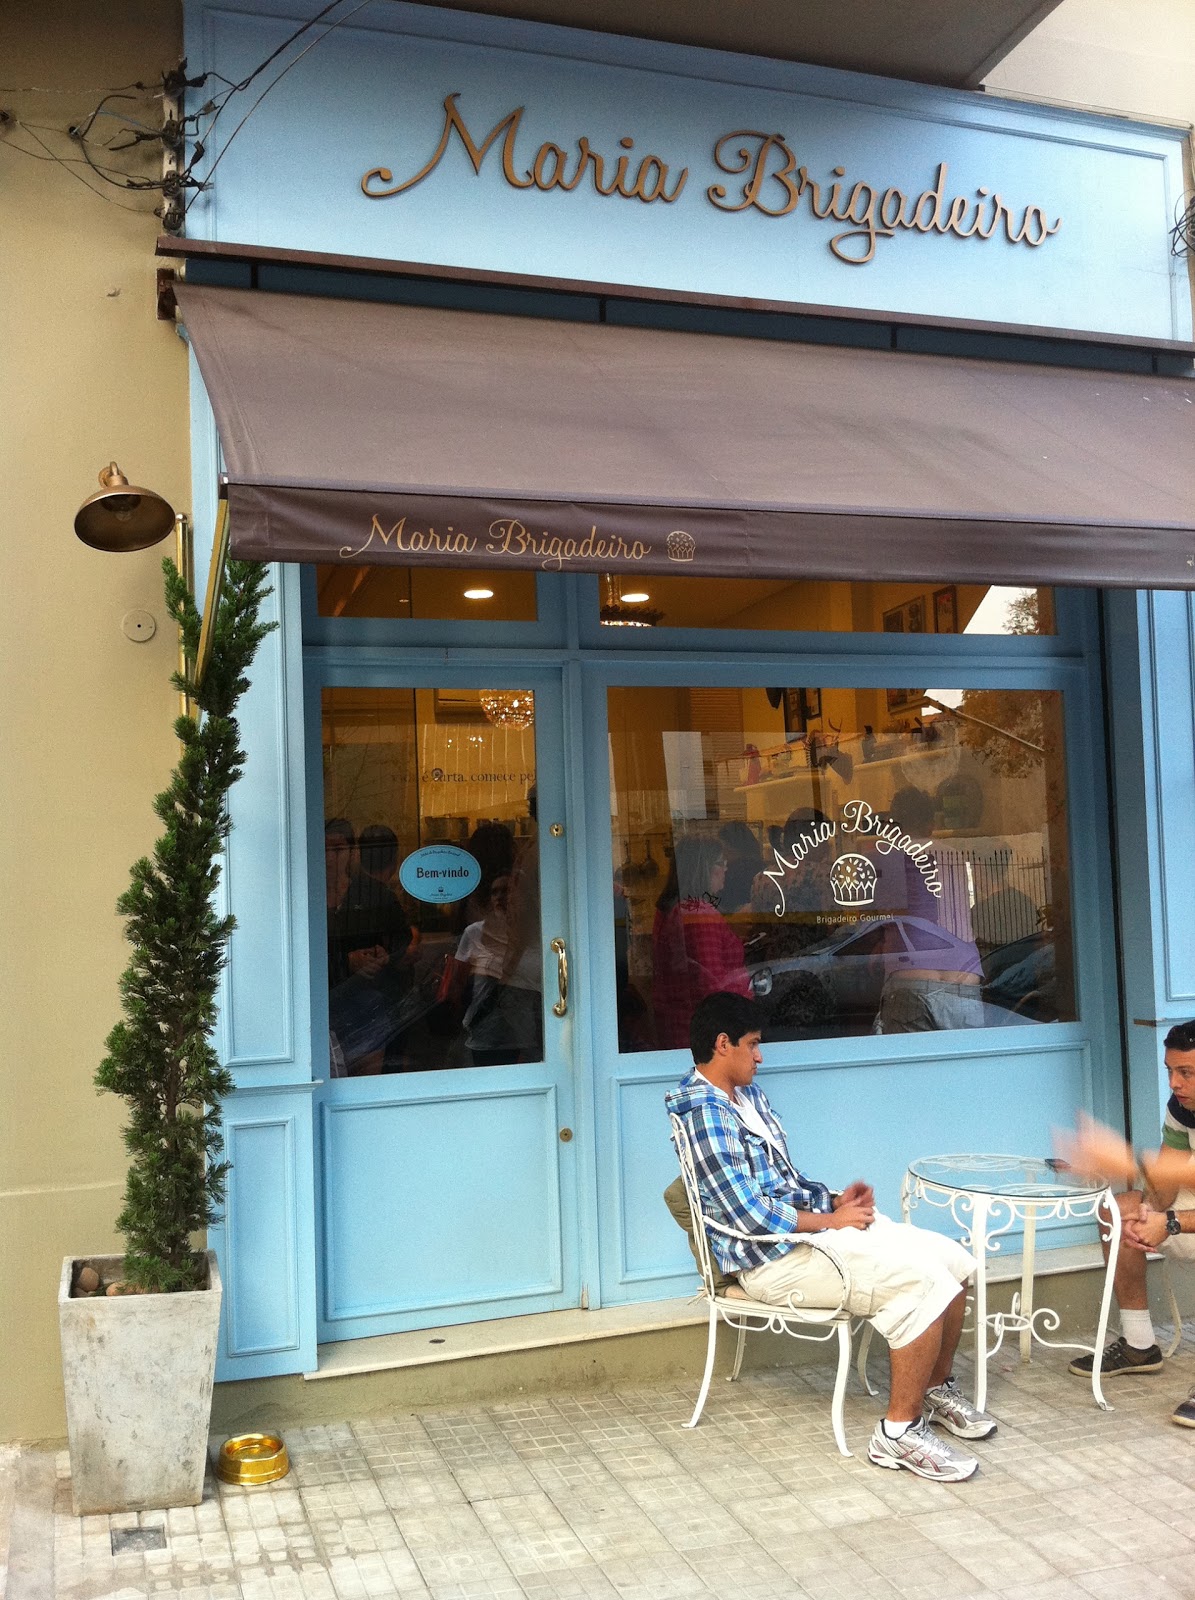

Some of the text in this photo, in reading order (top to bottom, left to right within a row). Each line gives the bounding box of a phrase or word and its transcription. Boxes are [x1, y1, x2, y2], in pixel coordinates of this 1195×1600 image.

[361, 92, 1064, 264] Maria Brigadeiro
[338, 512, 652, 572] Maria Brigadeiro
[470, 771, 516, 783] comece
[416, 866, 470, 879] Bem-vindo
[762, 799, 942, 918] Maria Brigadeiro
[816, 912, 895, 926] Brigadeiro Gourmet
